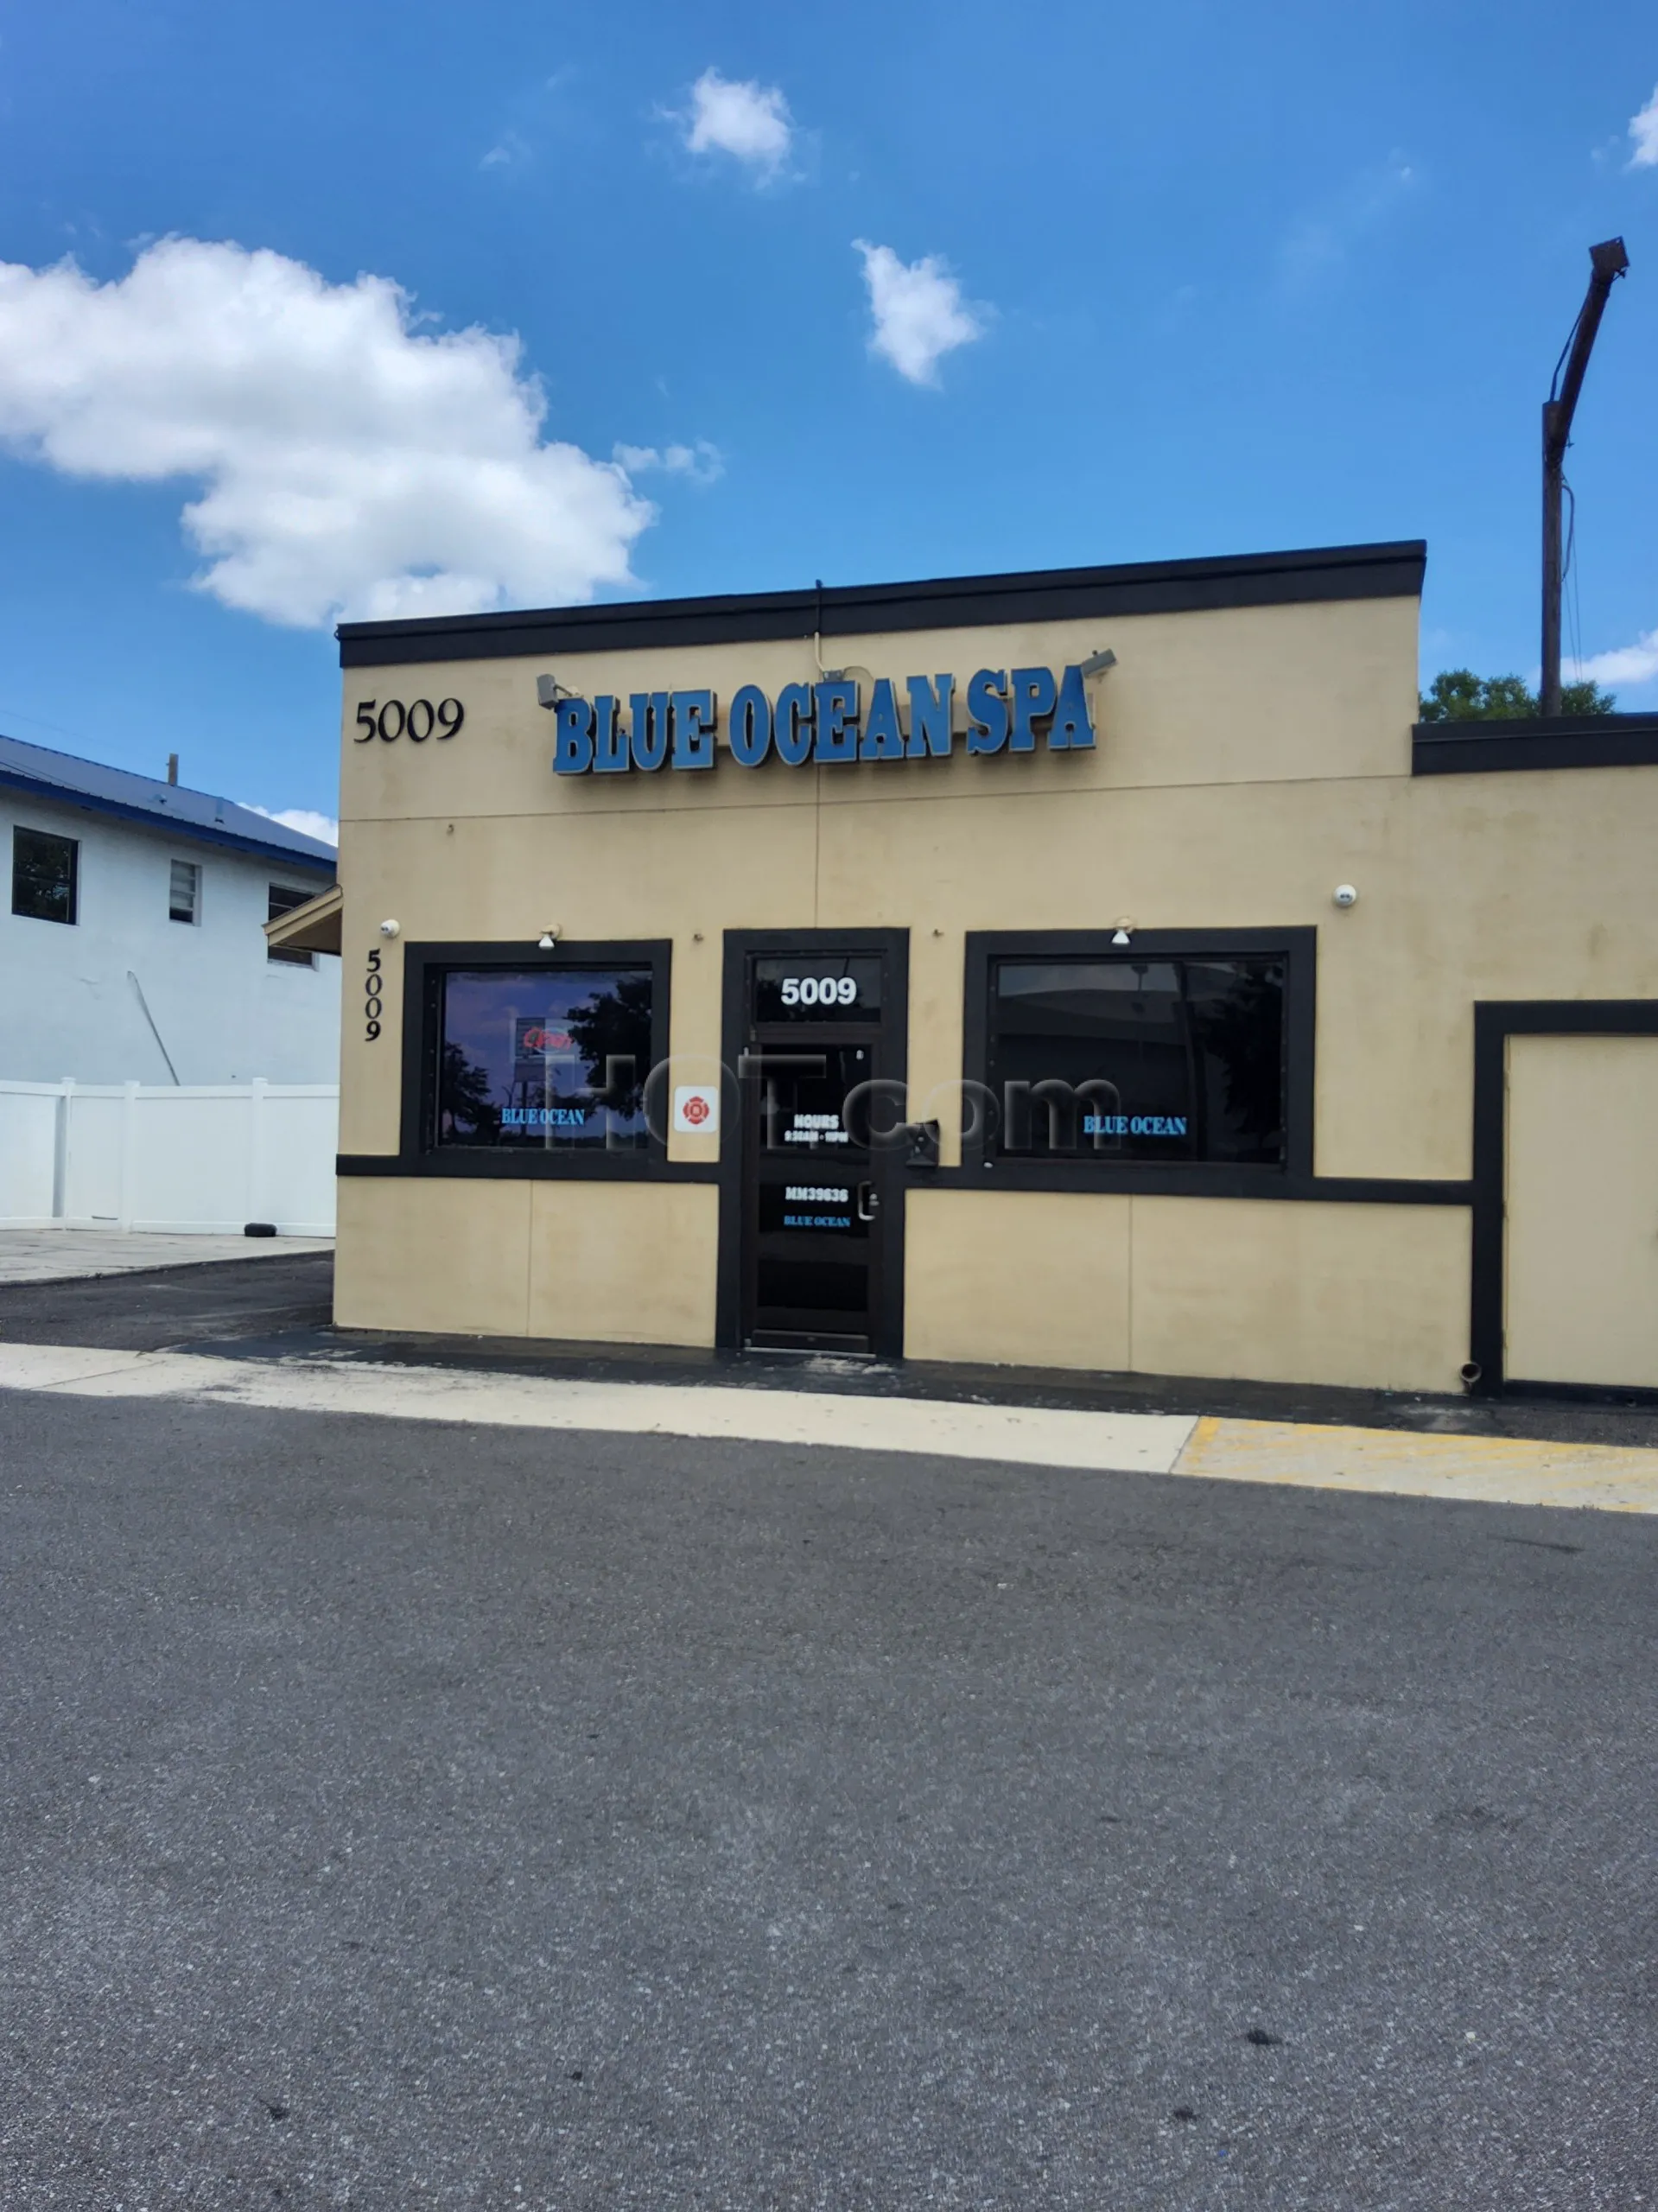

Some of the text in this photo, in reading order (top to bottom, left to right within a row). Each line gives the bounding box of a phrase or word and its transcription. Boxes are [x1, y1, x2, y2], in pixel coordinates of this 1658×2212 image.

[353, 697, 465, 745] 5009
[553, 664, 1097, 775] BLUE OCEAN SPA
[365, 948, 383, 1042] 5009
[781, 976, 857, 1005] 5009
[501, 1107, 585, 1126] BLUE OCEAN
[794, 1114, 839, 1129] HOURS
[1083, 1116, 1187, 1135] BLUE OCEAN
[784, 1215, 851, 1228] BLUE OCEAN
